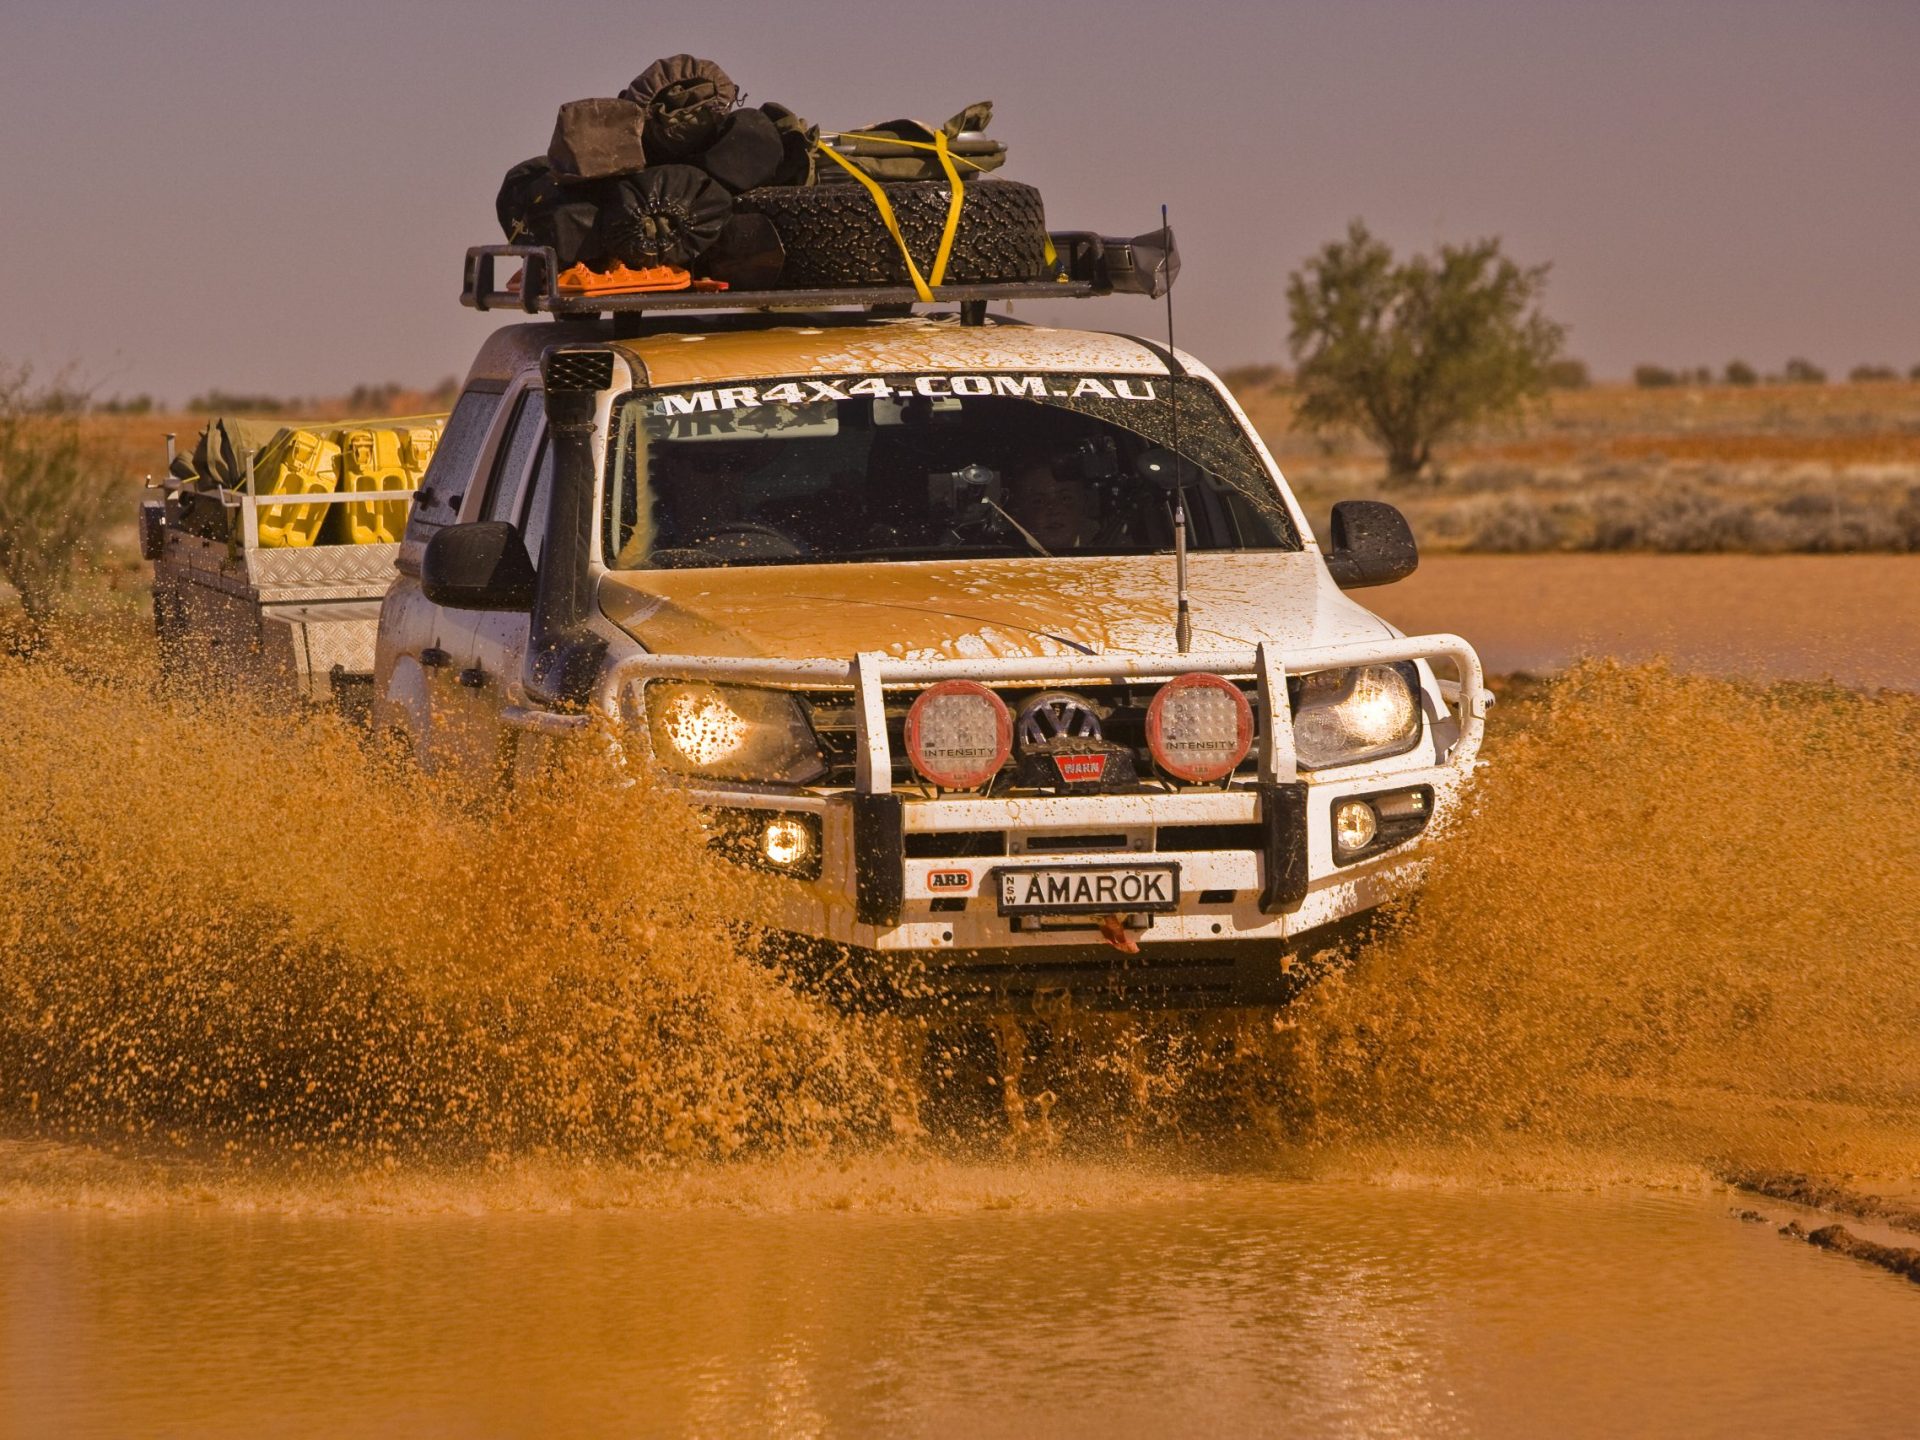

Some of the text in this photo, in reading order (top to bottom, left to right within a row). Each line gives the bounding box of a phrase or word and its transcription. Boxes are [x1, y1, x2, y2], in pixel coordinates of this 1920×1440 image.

[662, 376, 1157, 416] MR4X4.COM.AU
[1166, 741, 1235, 750] INTENSITY
[925, 748, 994, 757] INTENSITY
[1064, 763, 1099, 773] WARN
[933, 874, 968, 886] ARB
[1005, 877, 1016, 904] NSW
[1025, 874, 1166, 903] AMAROK
